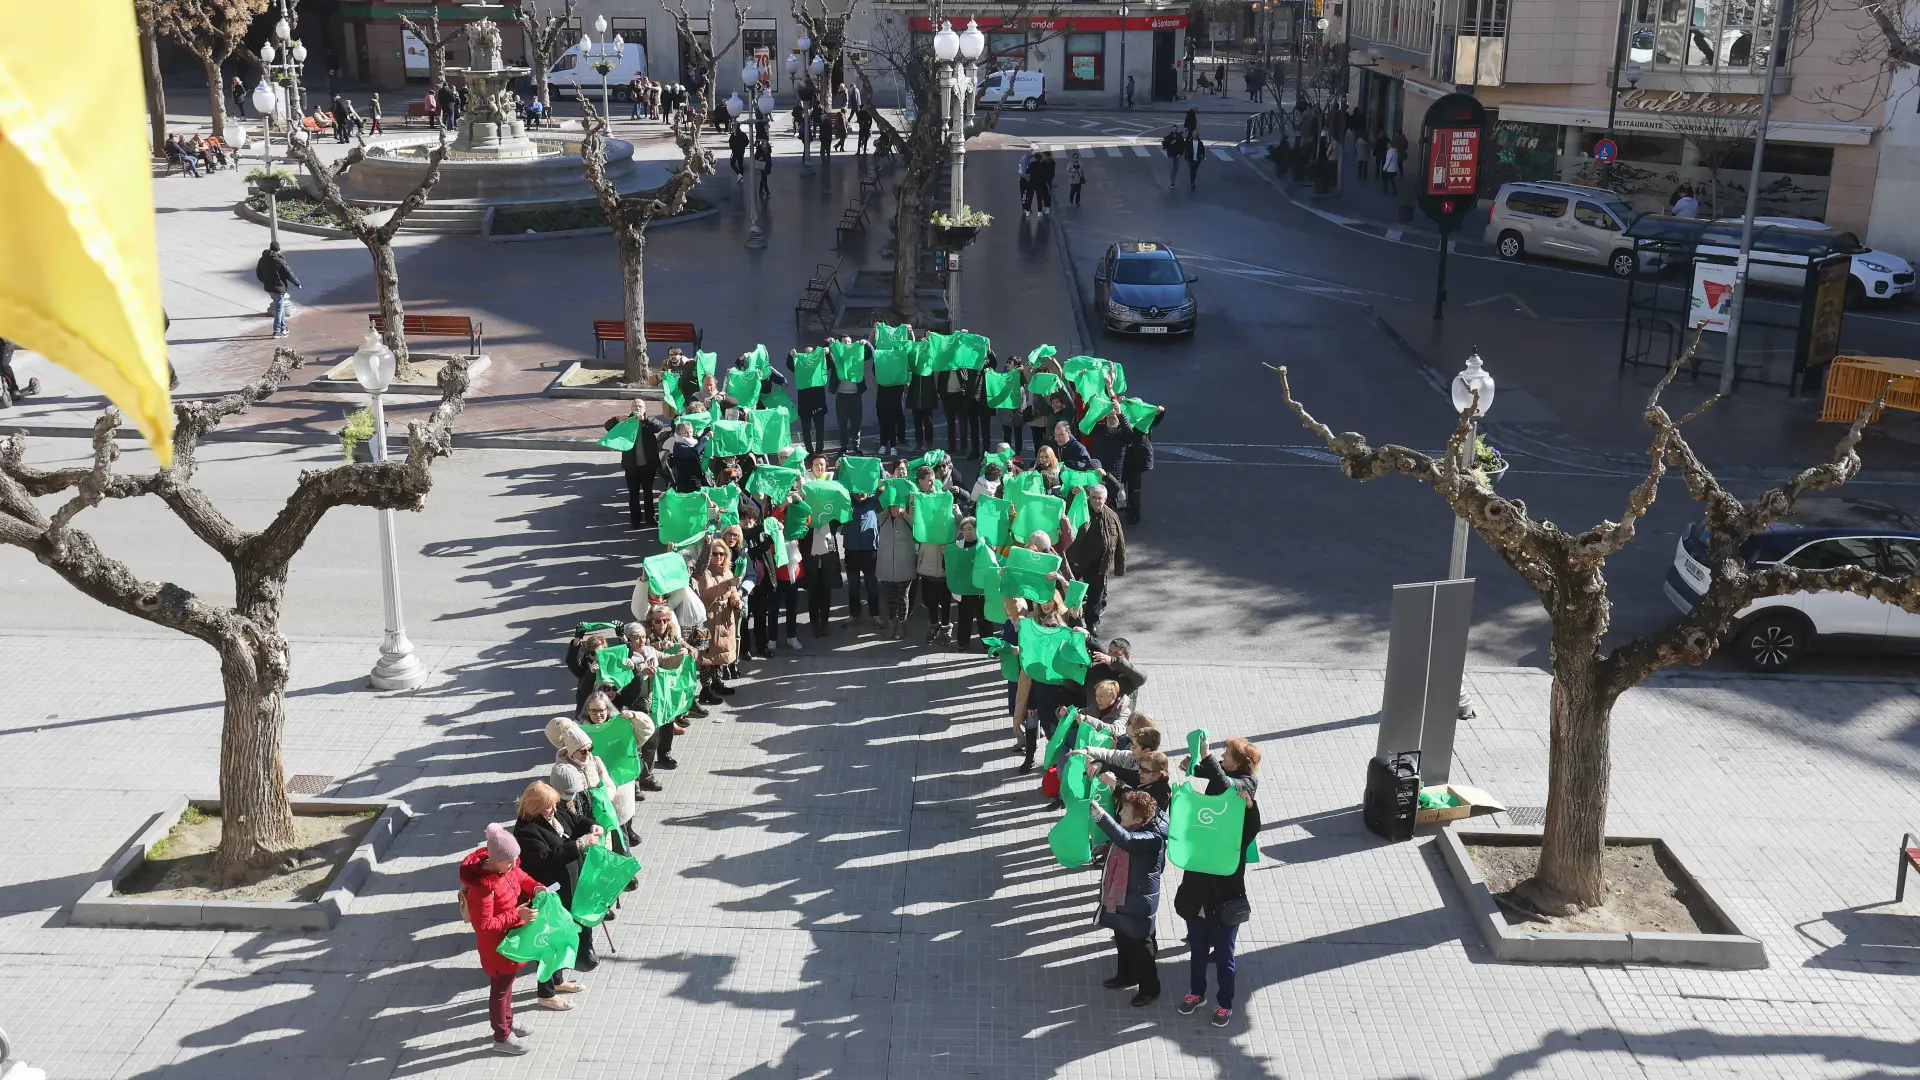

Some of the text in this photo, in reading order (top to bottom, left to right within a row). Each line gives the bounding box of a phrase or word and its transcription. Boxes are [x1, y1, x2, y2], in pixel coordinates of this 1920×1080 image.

[1157, 19, 1181, 28] Santander
[1614, 119, 1728, 134] RESTAURANTE GRANJA ANITA
[1452, 131, 1477, 139] UNA HORA
[1450, 153, 1473, 161] PRÓXIMO
[1449, 167, 1471, 176] LORENZO
